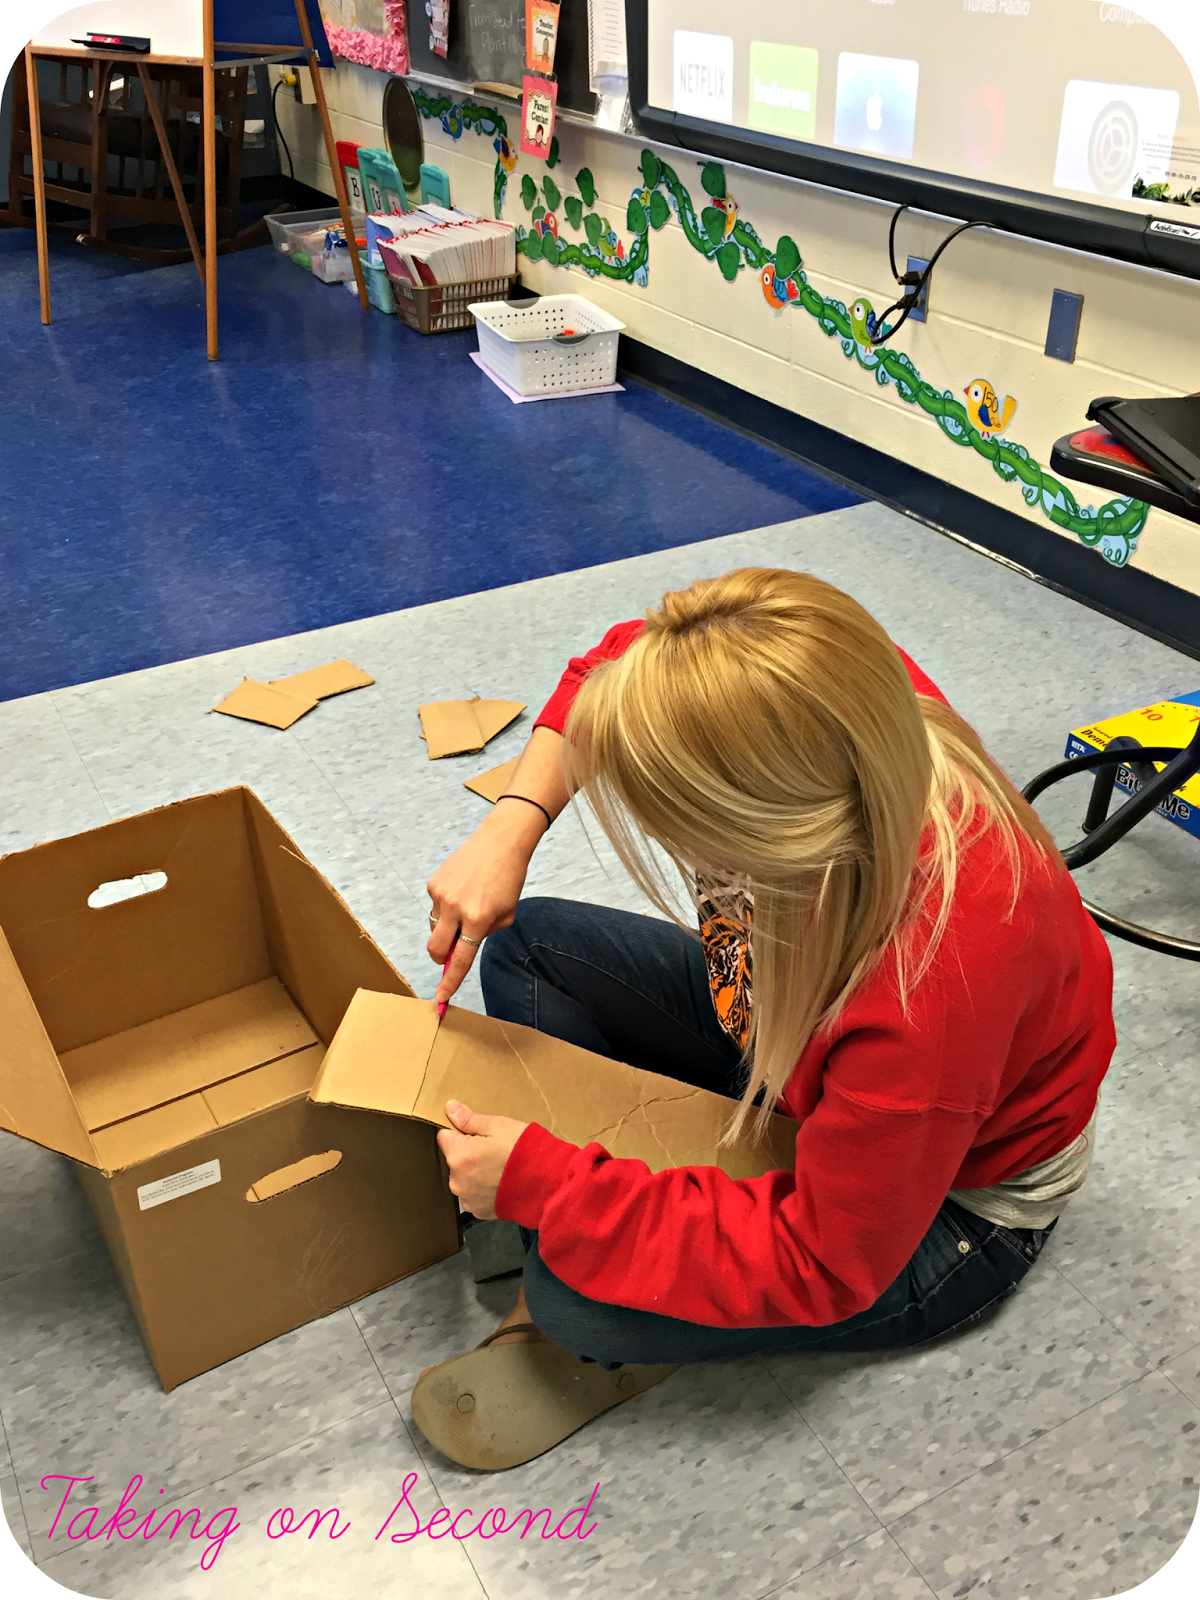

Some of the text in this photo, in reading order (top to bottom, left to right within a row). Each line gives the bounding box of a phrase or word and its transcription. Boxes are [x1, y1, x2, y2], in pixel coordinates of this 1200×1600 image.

[680, 62, 726, 102] NETFLIX
[533, 99, 550, 114] Parent
[531, 111, 549, 125] Contact
[351, 177, 360, 198] B
[982, 386, 999, 413] 150
[1141, 708, 1163, 721] 10
